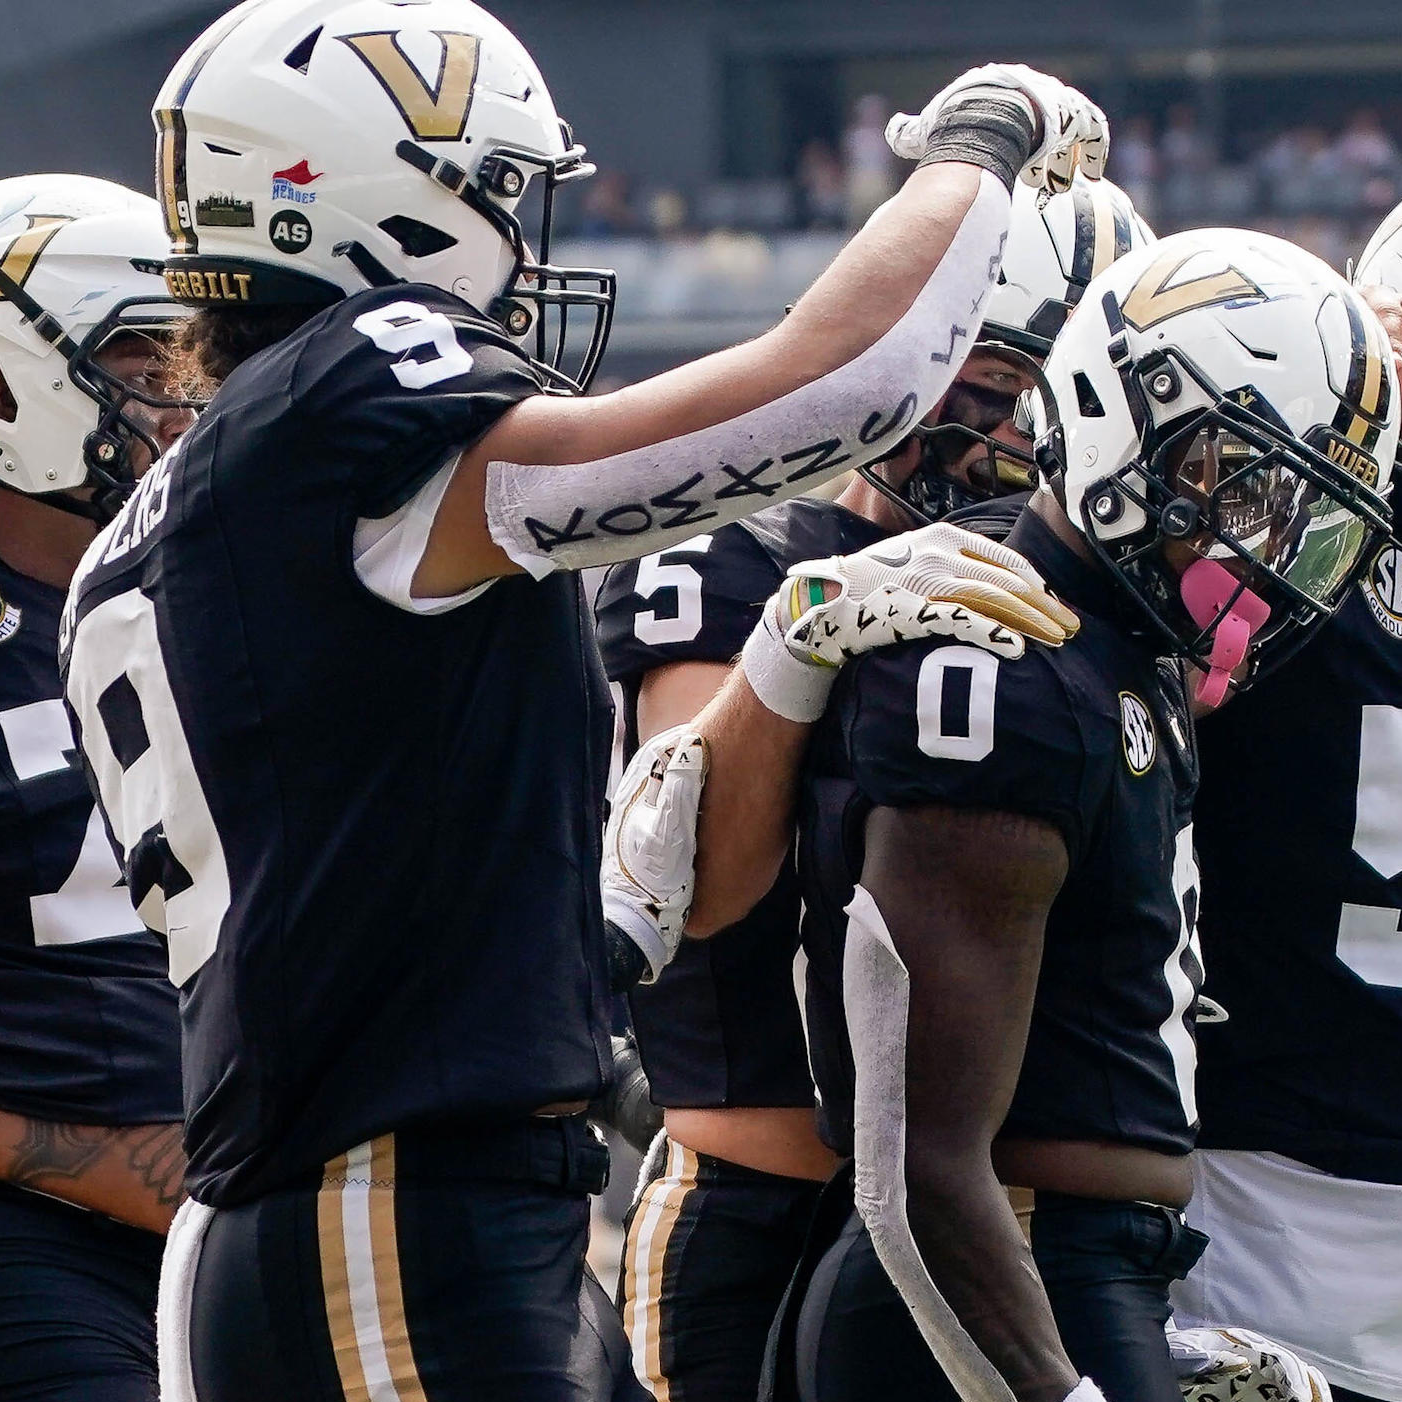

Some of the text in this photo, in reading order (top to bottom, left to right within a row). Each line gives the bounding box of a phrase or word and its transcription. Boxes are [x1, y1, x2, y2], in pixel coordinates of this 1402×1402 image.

[332, 29, 482, 142] V
[176, 200, 192, 229] 9
[274, 221, 309, 243] AS
[352, 300, 474, 390] 9
[1326, 438, 1379, 487] VUFB
[634, 534, 713, 646] 5
[917, 645, 999, 763] 0
[1122, 696, 1154, 770] SEC
[66, 587, 231, 989] 9
